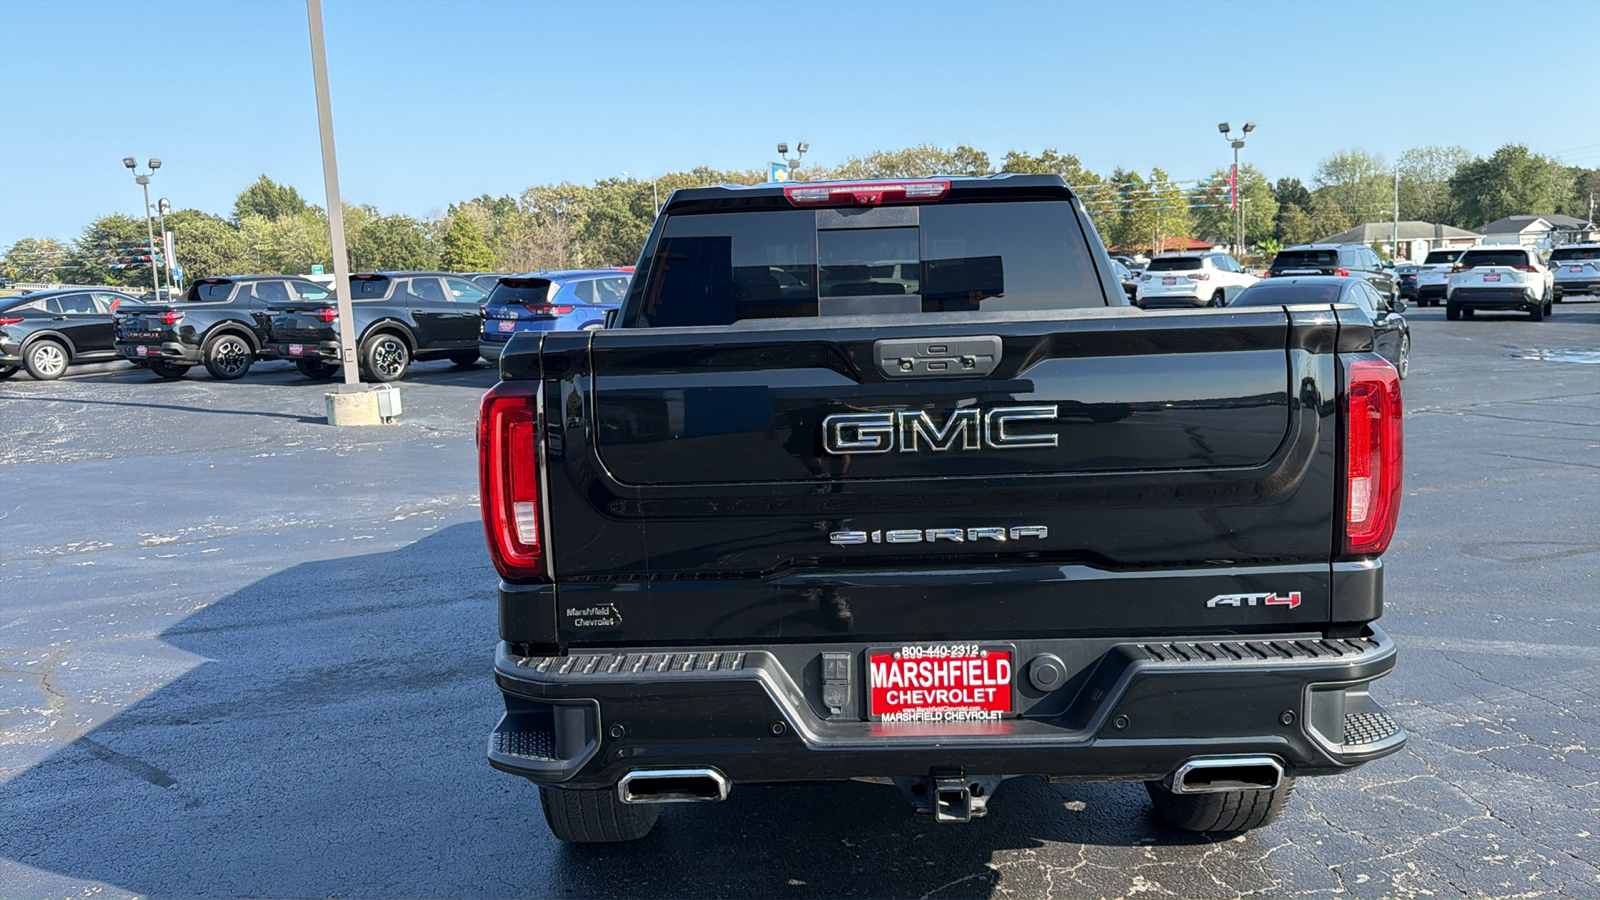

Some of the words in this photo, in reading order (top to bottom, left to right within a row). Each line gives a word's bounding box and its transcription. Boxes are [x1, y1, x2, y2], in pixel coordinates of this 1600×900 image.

[822, 405, 1058, 455] GMC
[829, 526, 1048, 544] SIERRA
[1206, 591, 1301, 609] AT4
[566, 607, 610, 617] Marshfield
[574, 617, 614, 627] Chevrolet
[902, 645, 979, 656] 800-440-2312
[870, 659, 1011, 688] MARSHFIELD
[886, 688, 997, 704] CHEVROLET
[881, 711, 942, 722] MARSHFIELD
[944, 710, 1003, 720] CHEVROLET
